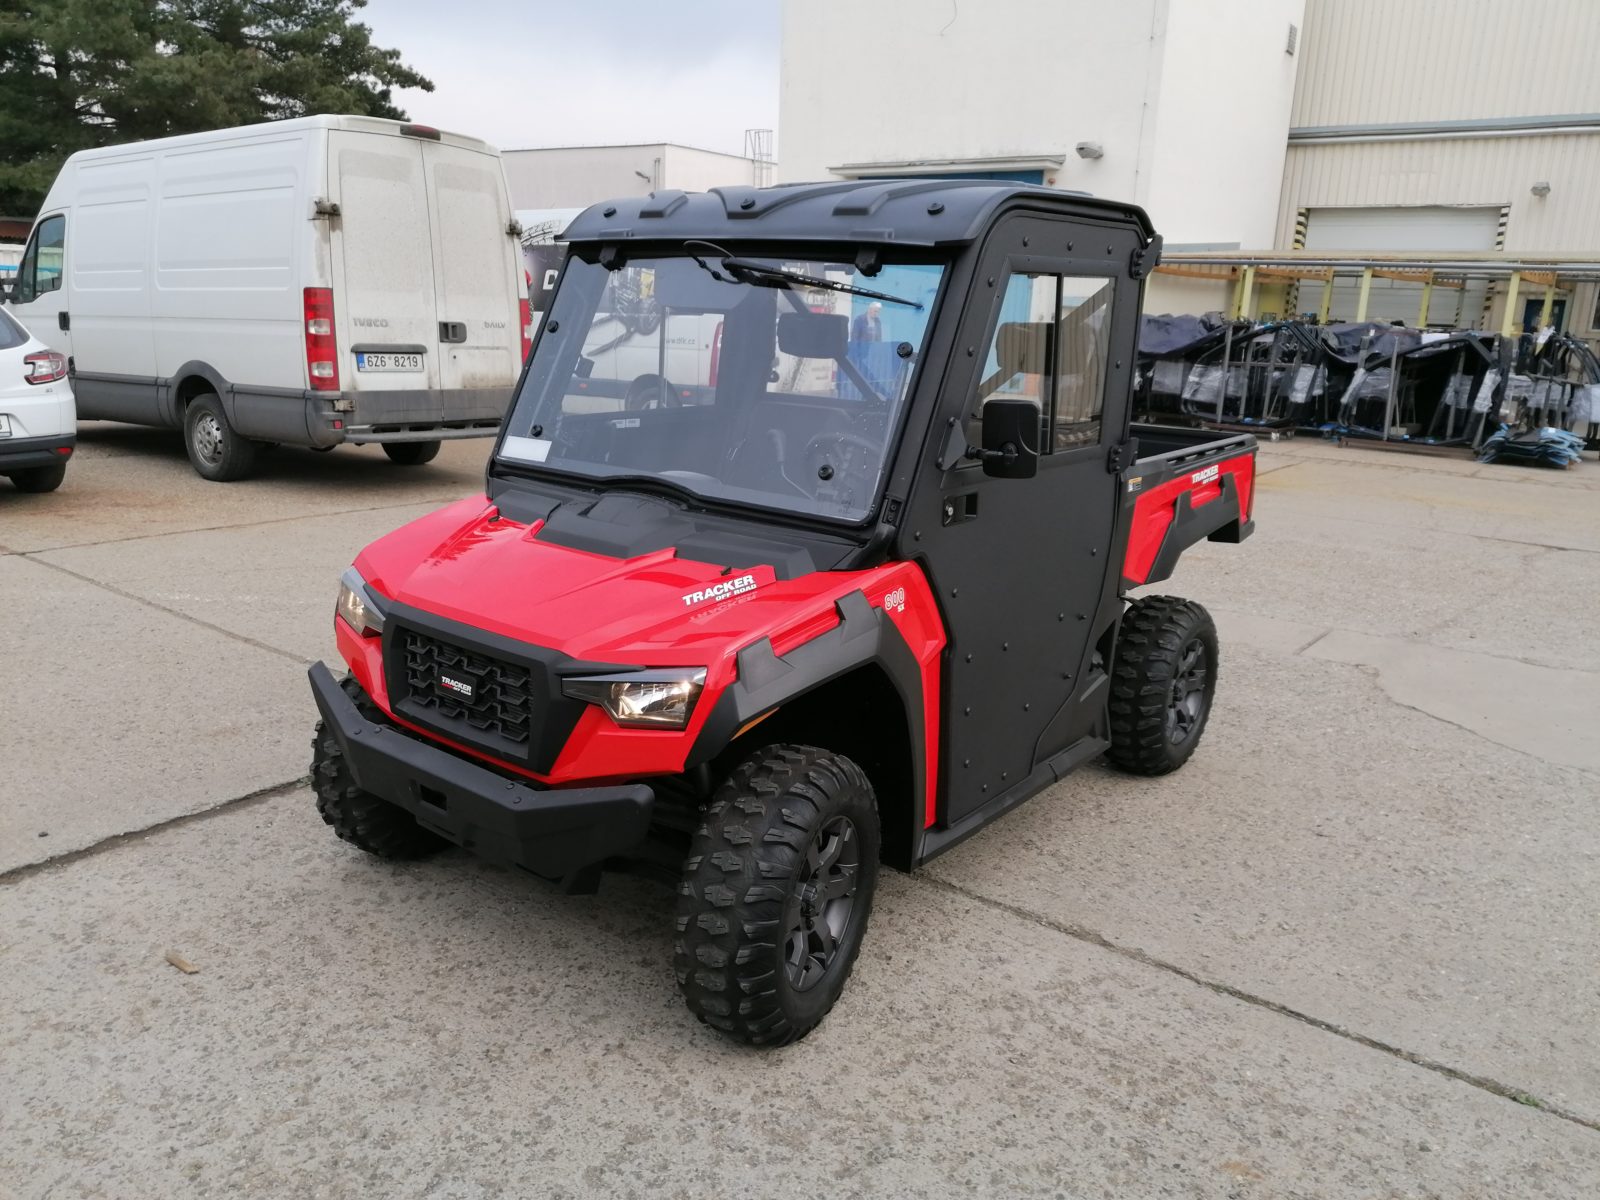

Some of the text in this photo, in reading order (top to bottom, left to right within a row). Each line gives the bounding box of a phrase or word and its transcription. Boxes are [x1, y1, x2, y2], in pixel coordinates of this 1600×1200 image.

[353, 318, 389, 327] IVECO
[367, 355, 418, 368] 6Z6 8219
[1191, 464, 1219, 484] TRACKER
[682, 574, 755, 606] TRACKER
[715, 584, 757, 601] OFF ROAD
[441, 675, 472, 693] TRACKER
